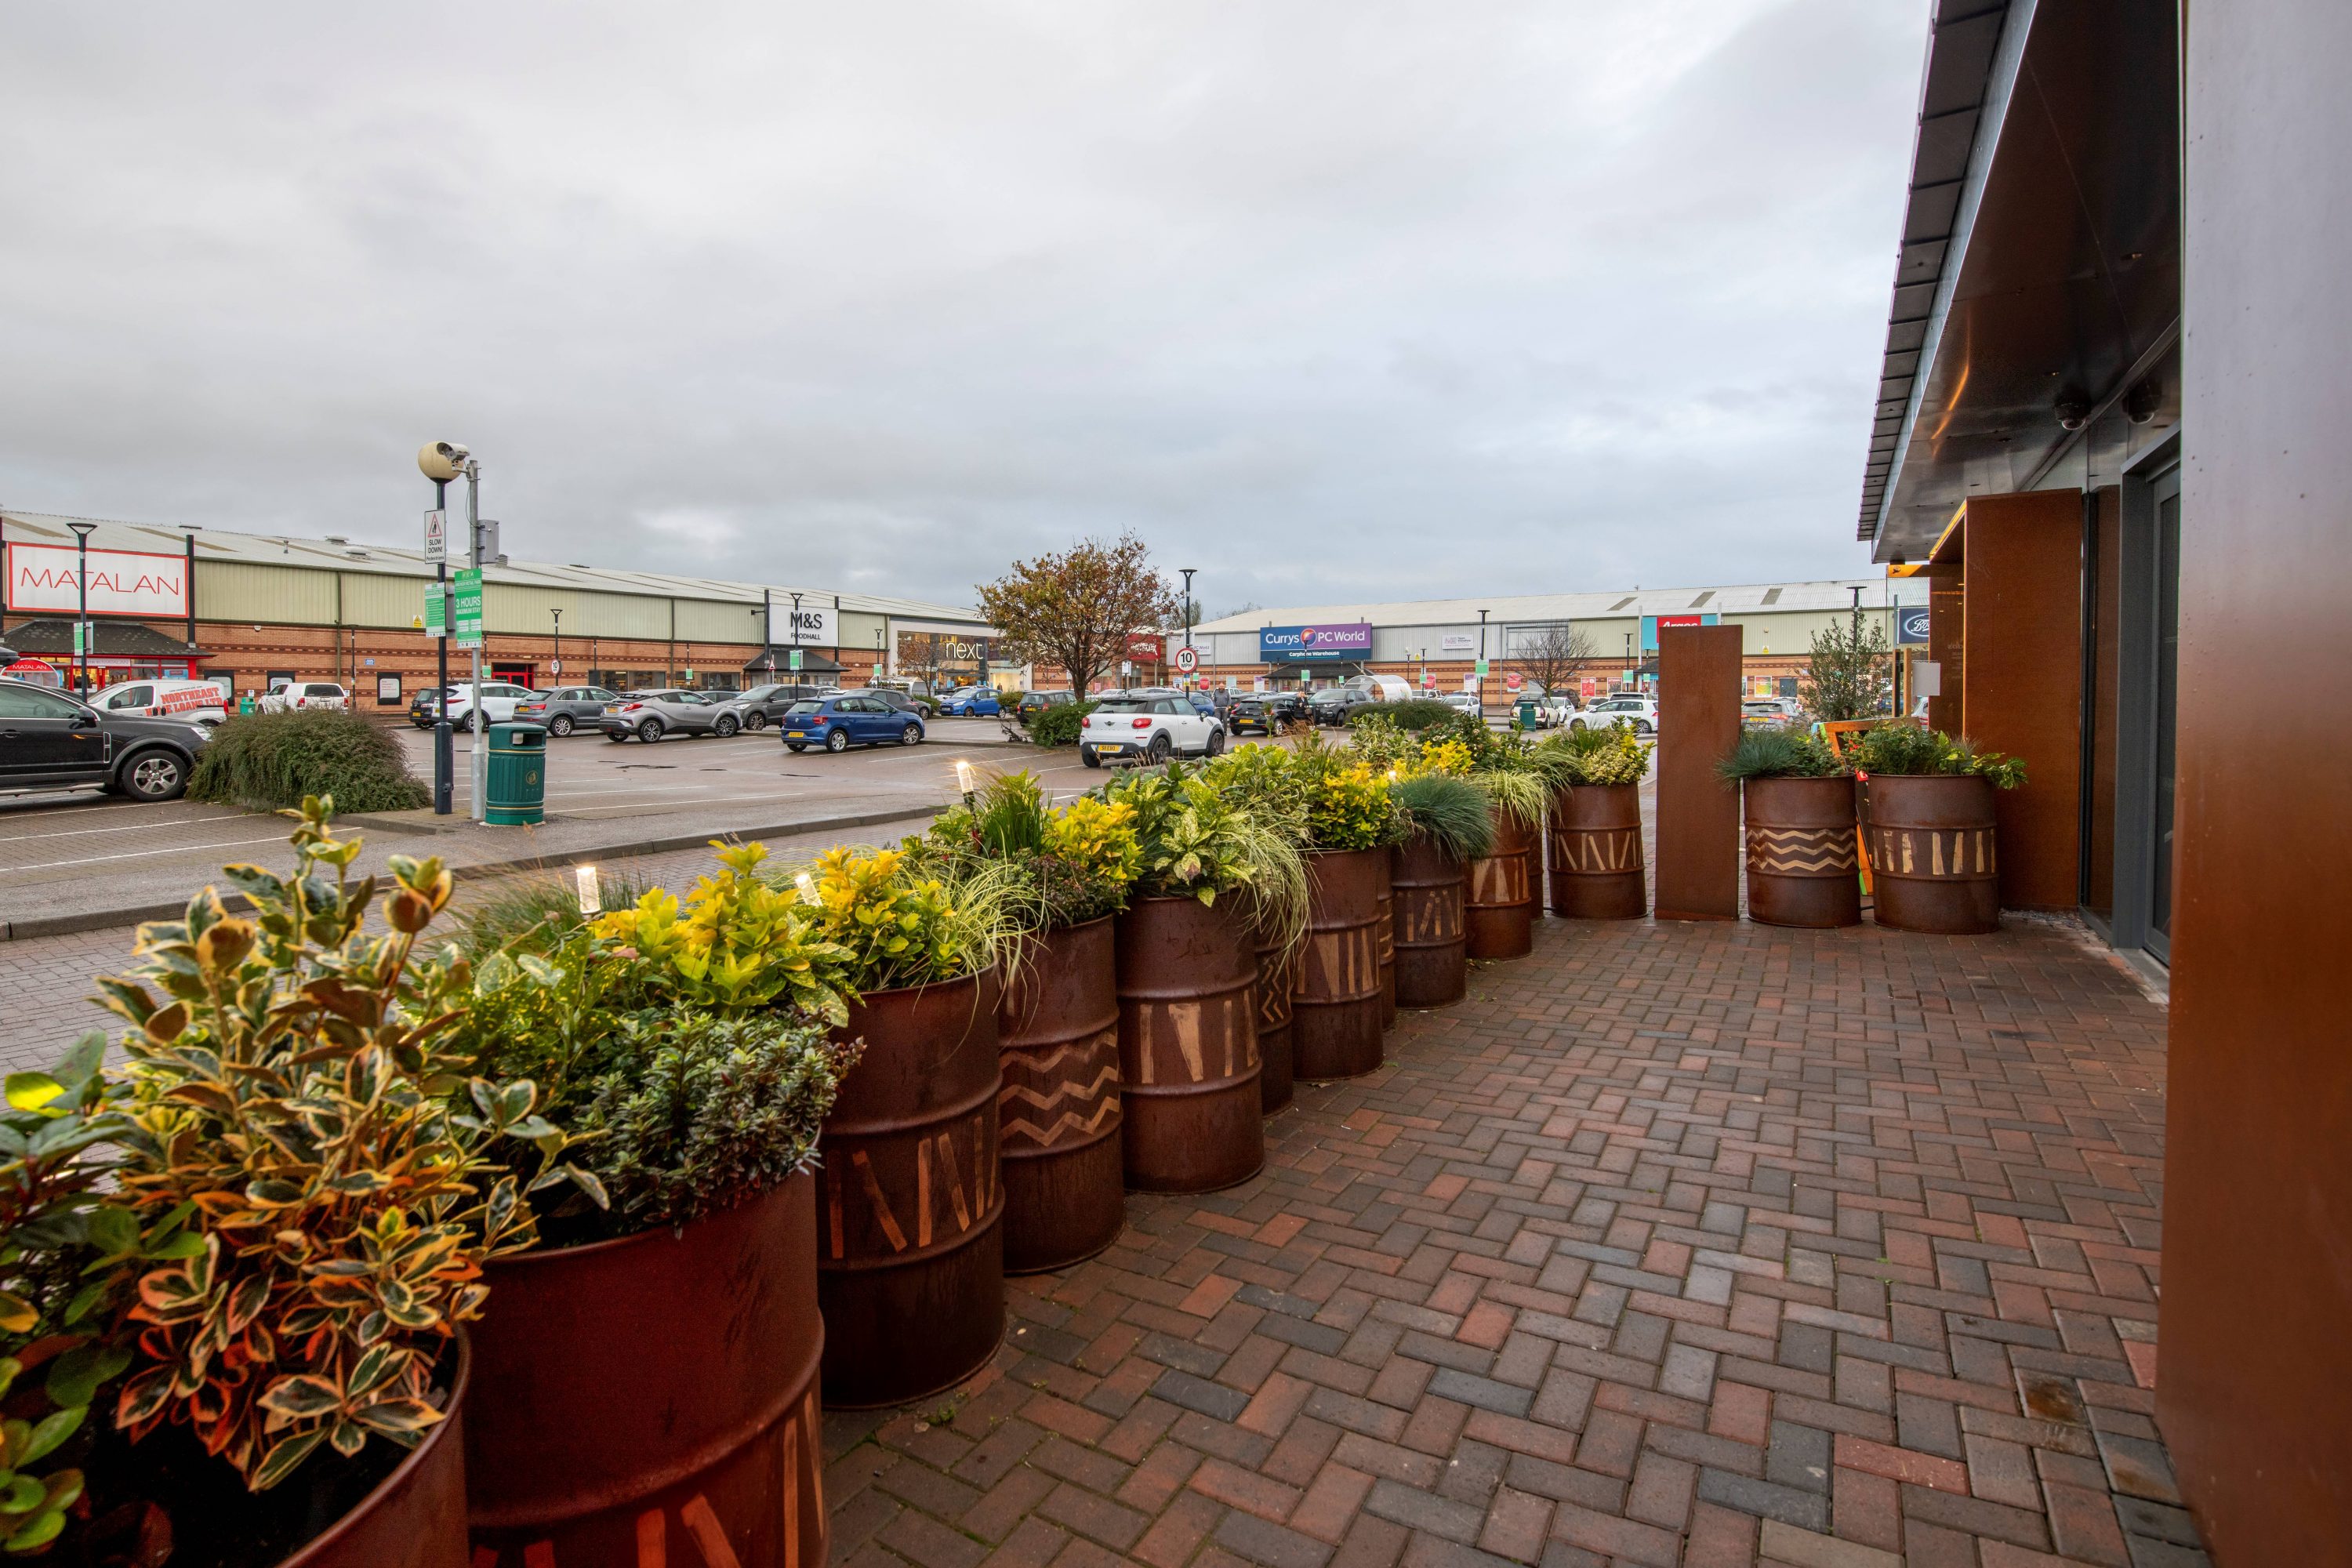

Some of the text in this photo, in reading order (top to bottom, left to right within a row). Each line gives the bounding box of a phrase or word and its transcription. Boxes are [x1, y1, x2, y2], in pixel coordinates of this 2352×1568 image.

[456, 596, 481, 608] 3 HOURS
[790, 612, 822, 630] M&S
[1265, 630, 1365, 645] Currys PC World
[946, 642, 984, 659] next
[1180, 652, 1192, 663] 10
[161, 687, 220, 704] NORTHEAST
[144, 696, 223, 717] HE LOANS LTD
